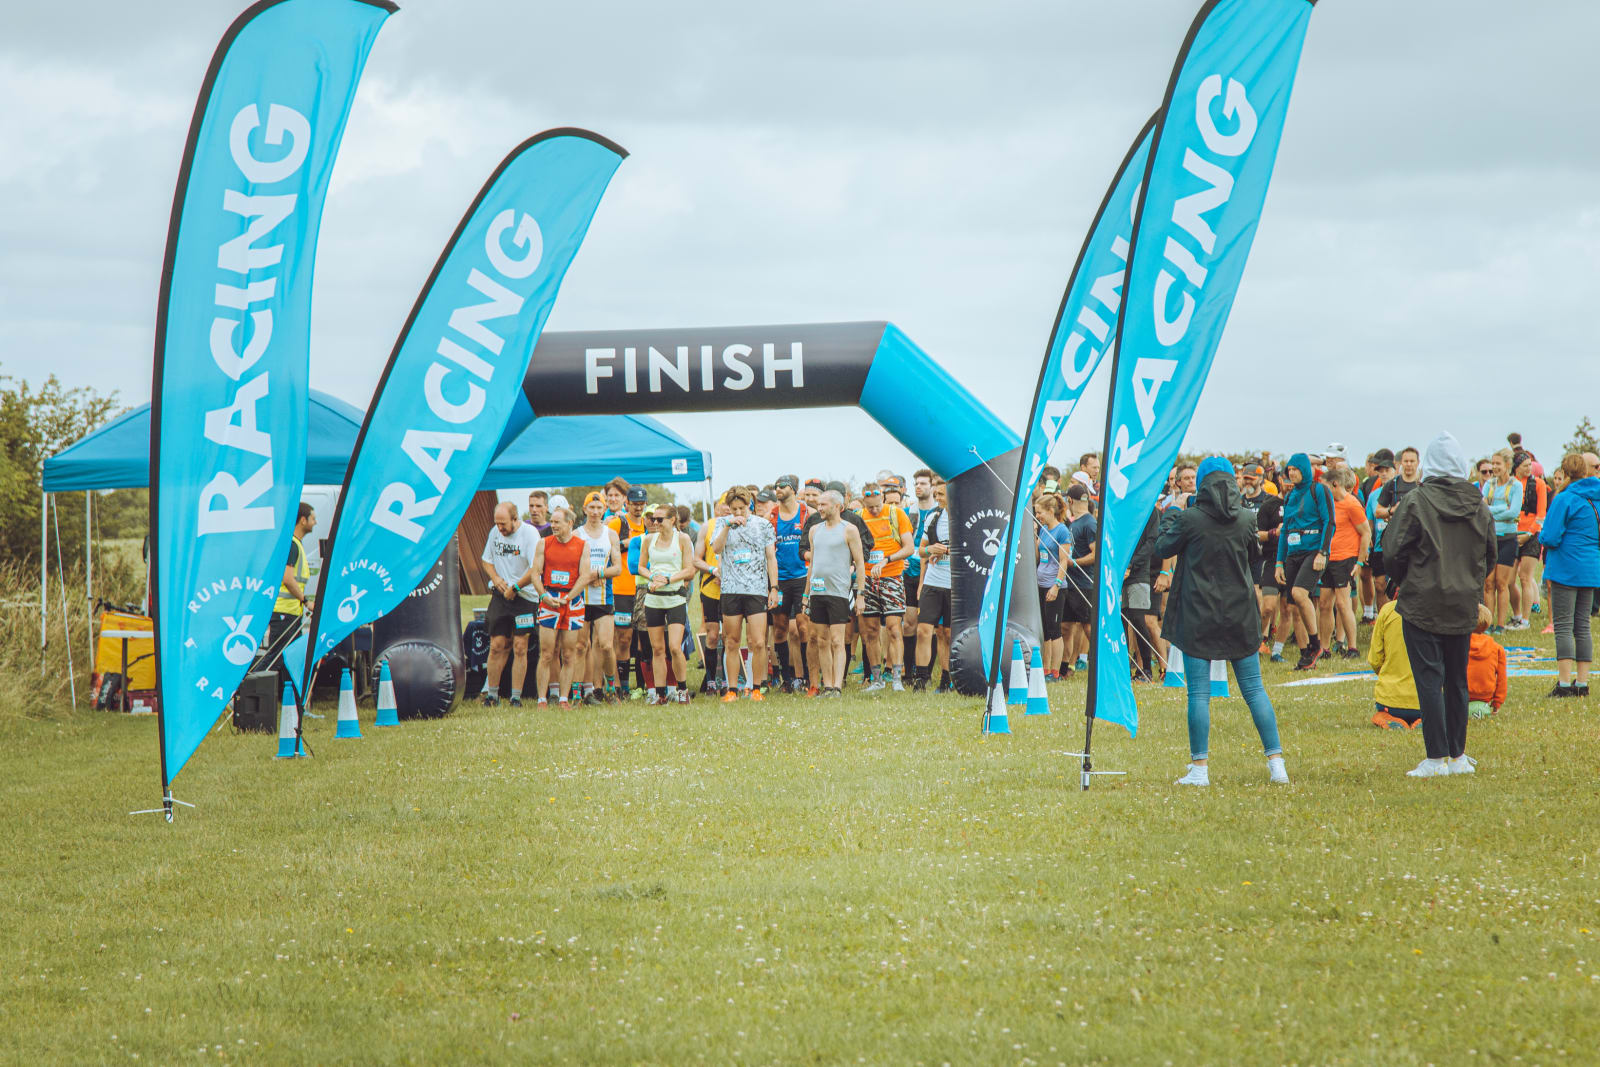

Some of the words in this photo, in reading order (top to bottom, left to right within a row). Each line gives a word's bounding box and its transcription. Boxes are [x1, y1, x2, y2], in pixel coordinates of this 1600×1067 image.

[197, 103, 311, 537] RACING
[369, 208, 544, 544] RACING
[585, 341, 805, 395] FINISH
[1025, 180, 1143, 499] ACIN
[1108, 73, 1258, 499] RACING
[187, 576, 275, 613] RUNAWA
[408, 573, 443, 598] NTURES
[964, 509, 1010, 529] RUNAWA
